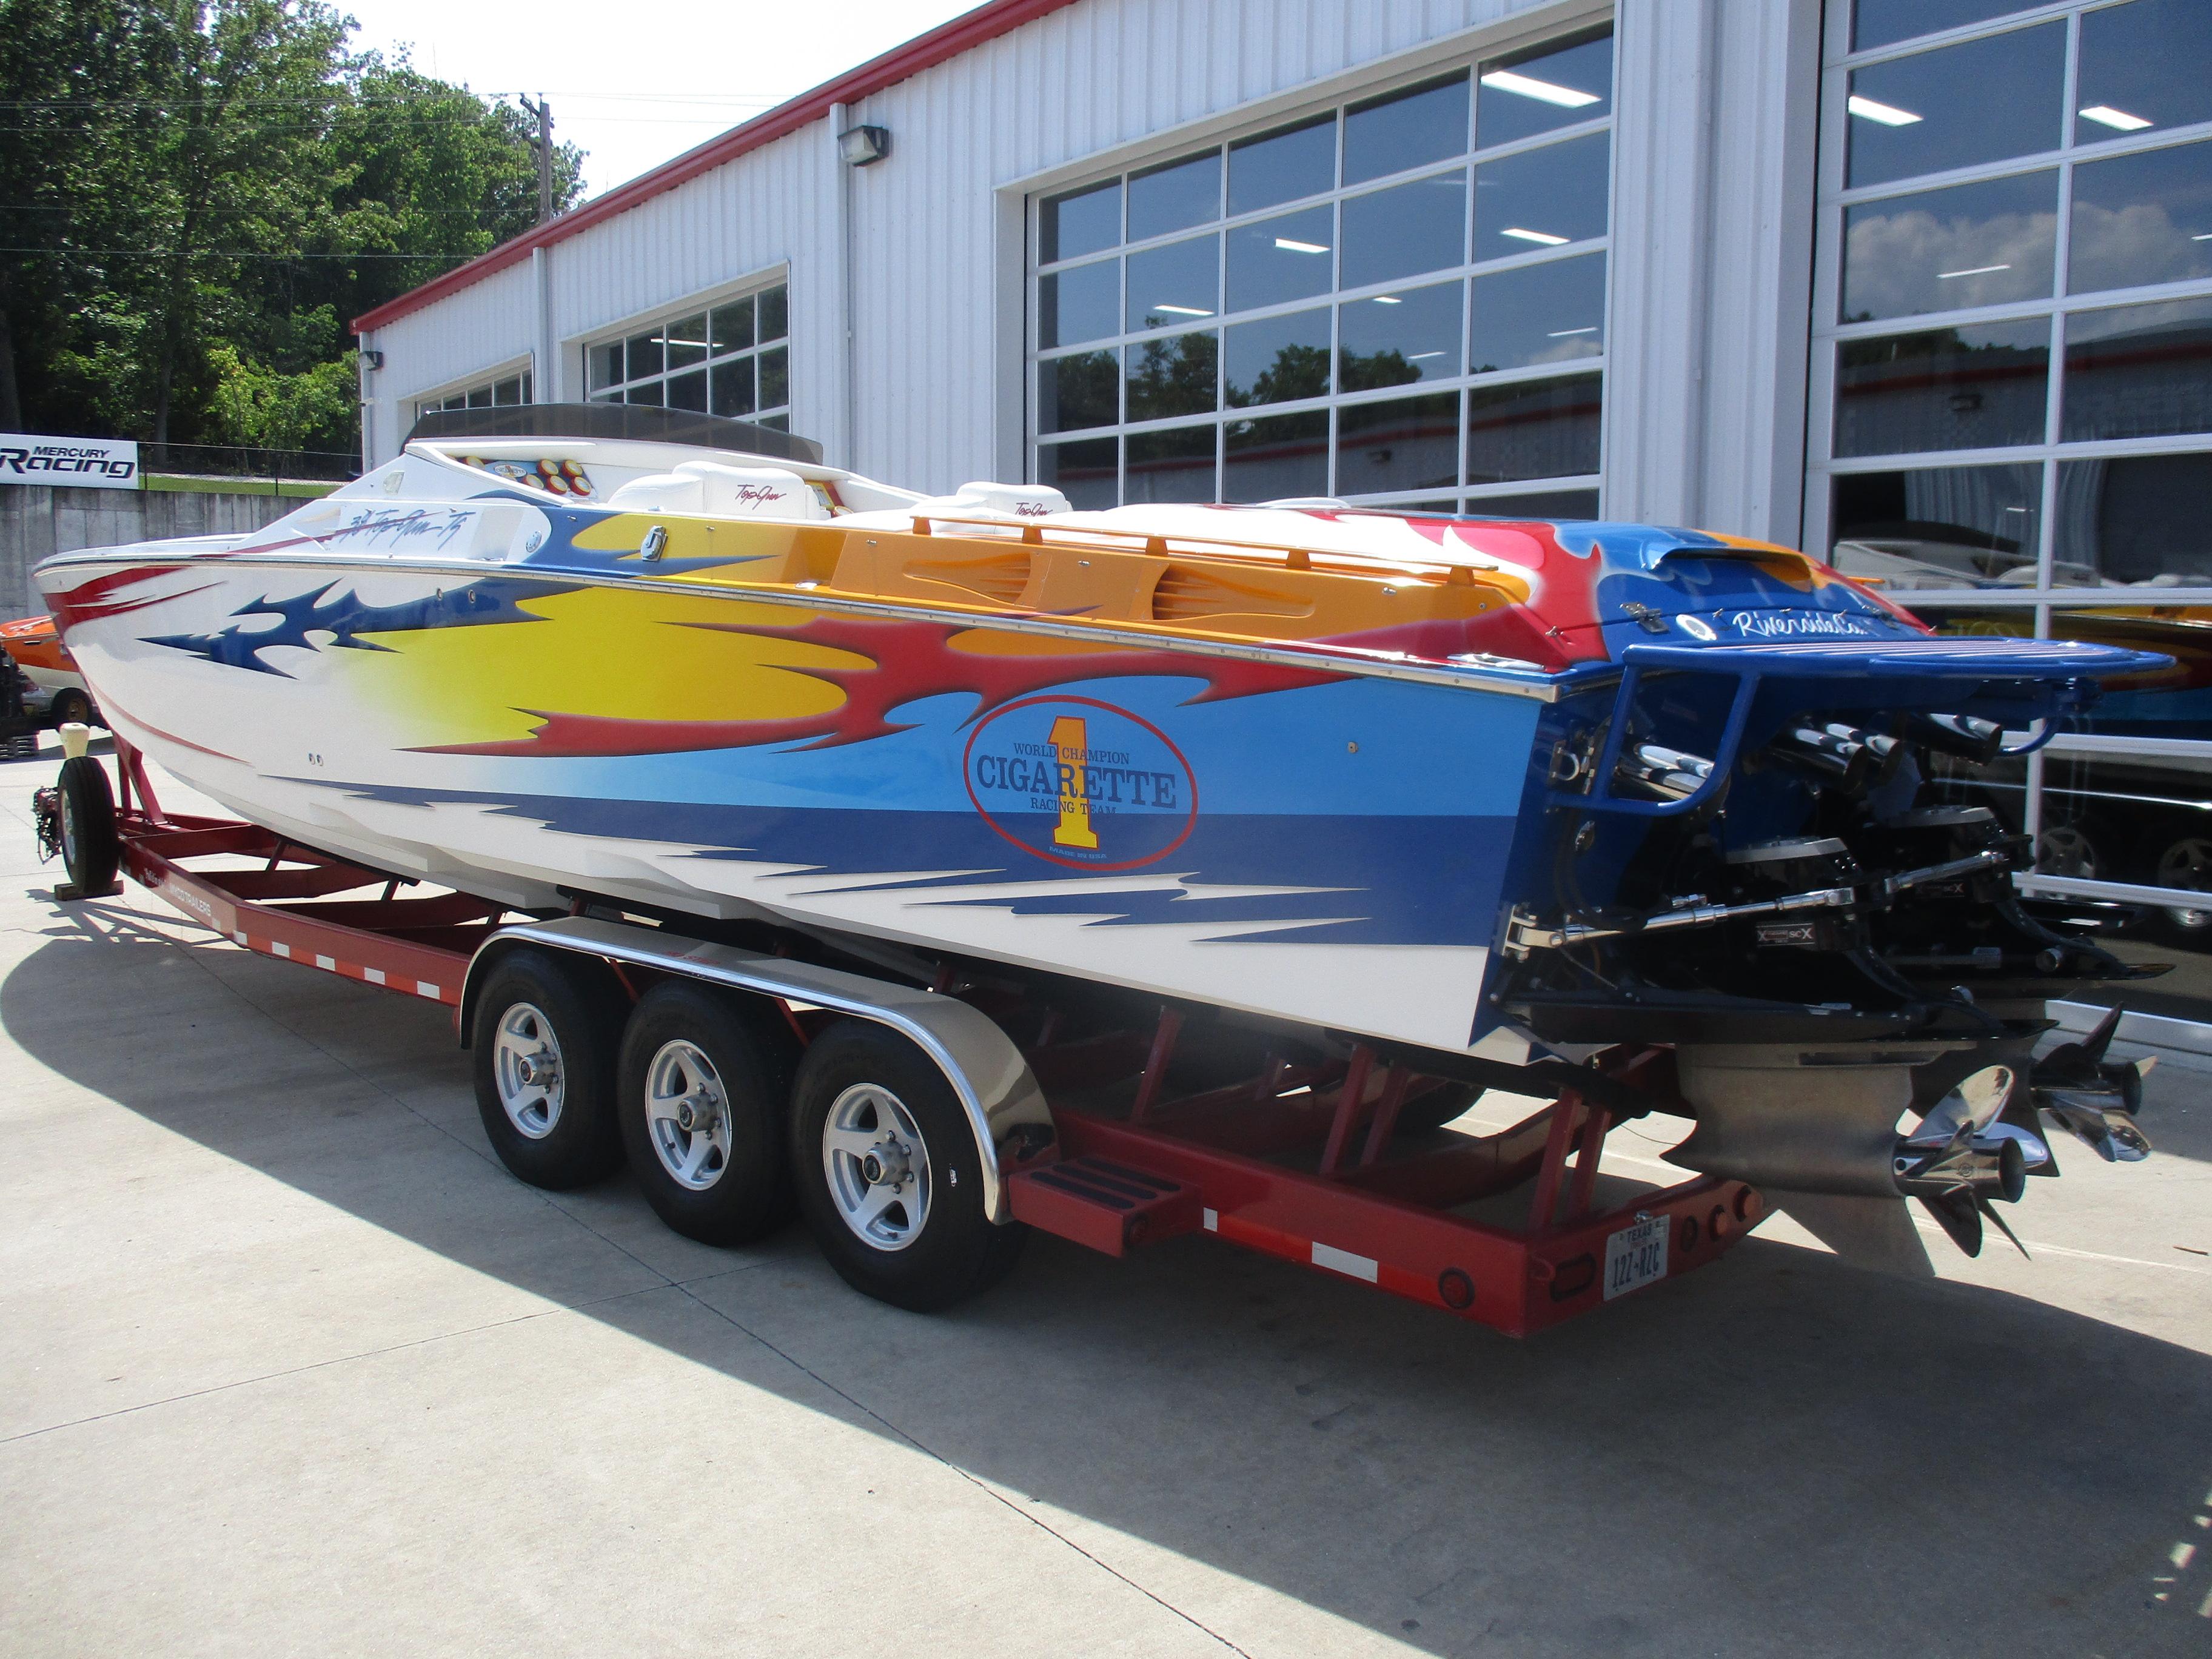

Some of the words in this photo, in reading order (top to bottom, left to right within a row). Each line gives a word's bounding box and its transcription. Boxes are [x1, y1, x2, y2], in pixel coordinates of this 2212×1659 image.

[33, 446, 111, 458] MERCURY
[0, 447, 135, 479] Racing
[1014, 742, 1057, 758] WORLD
[1062, 746, 1130, 765] CHAMPION
[976, 754, 1177, 809] CIGARETTE
[1047, 715, 1099, 850] 1
[1031, 797, 1075, 814] RACING
[1080, 802, 1117, 816] TEAM
[1049, 846, 1076, 857] MADE
[1627, 1223, 1652, 1243] TEXAS
